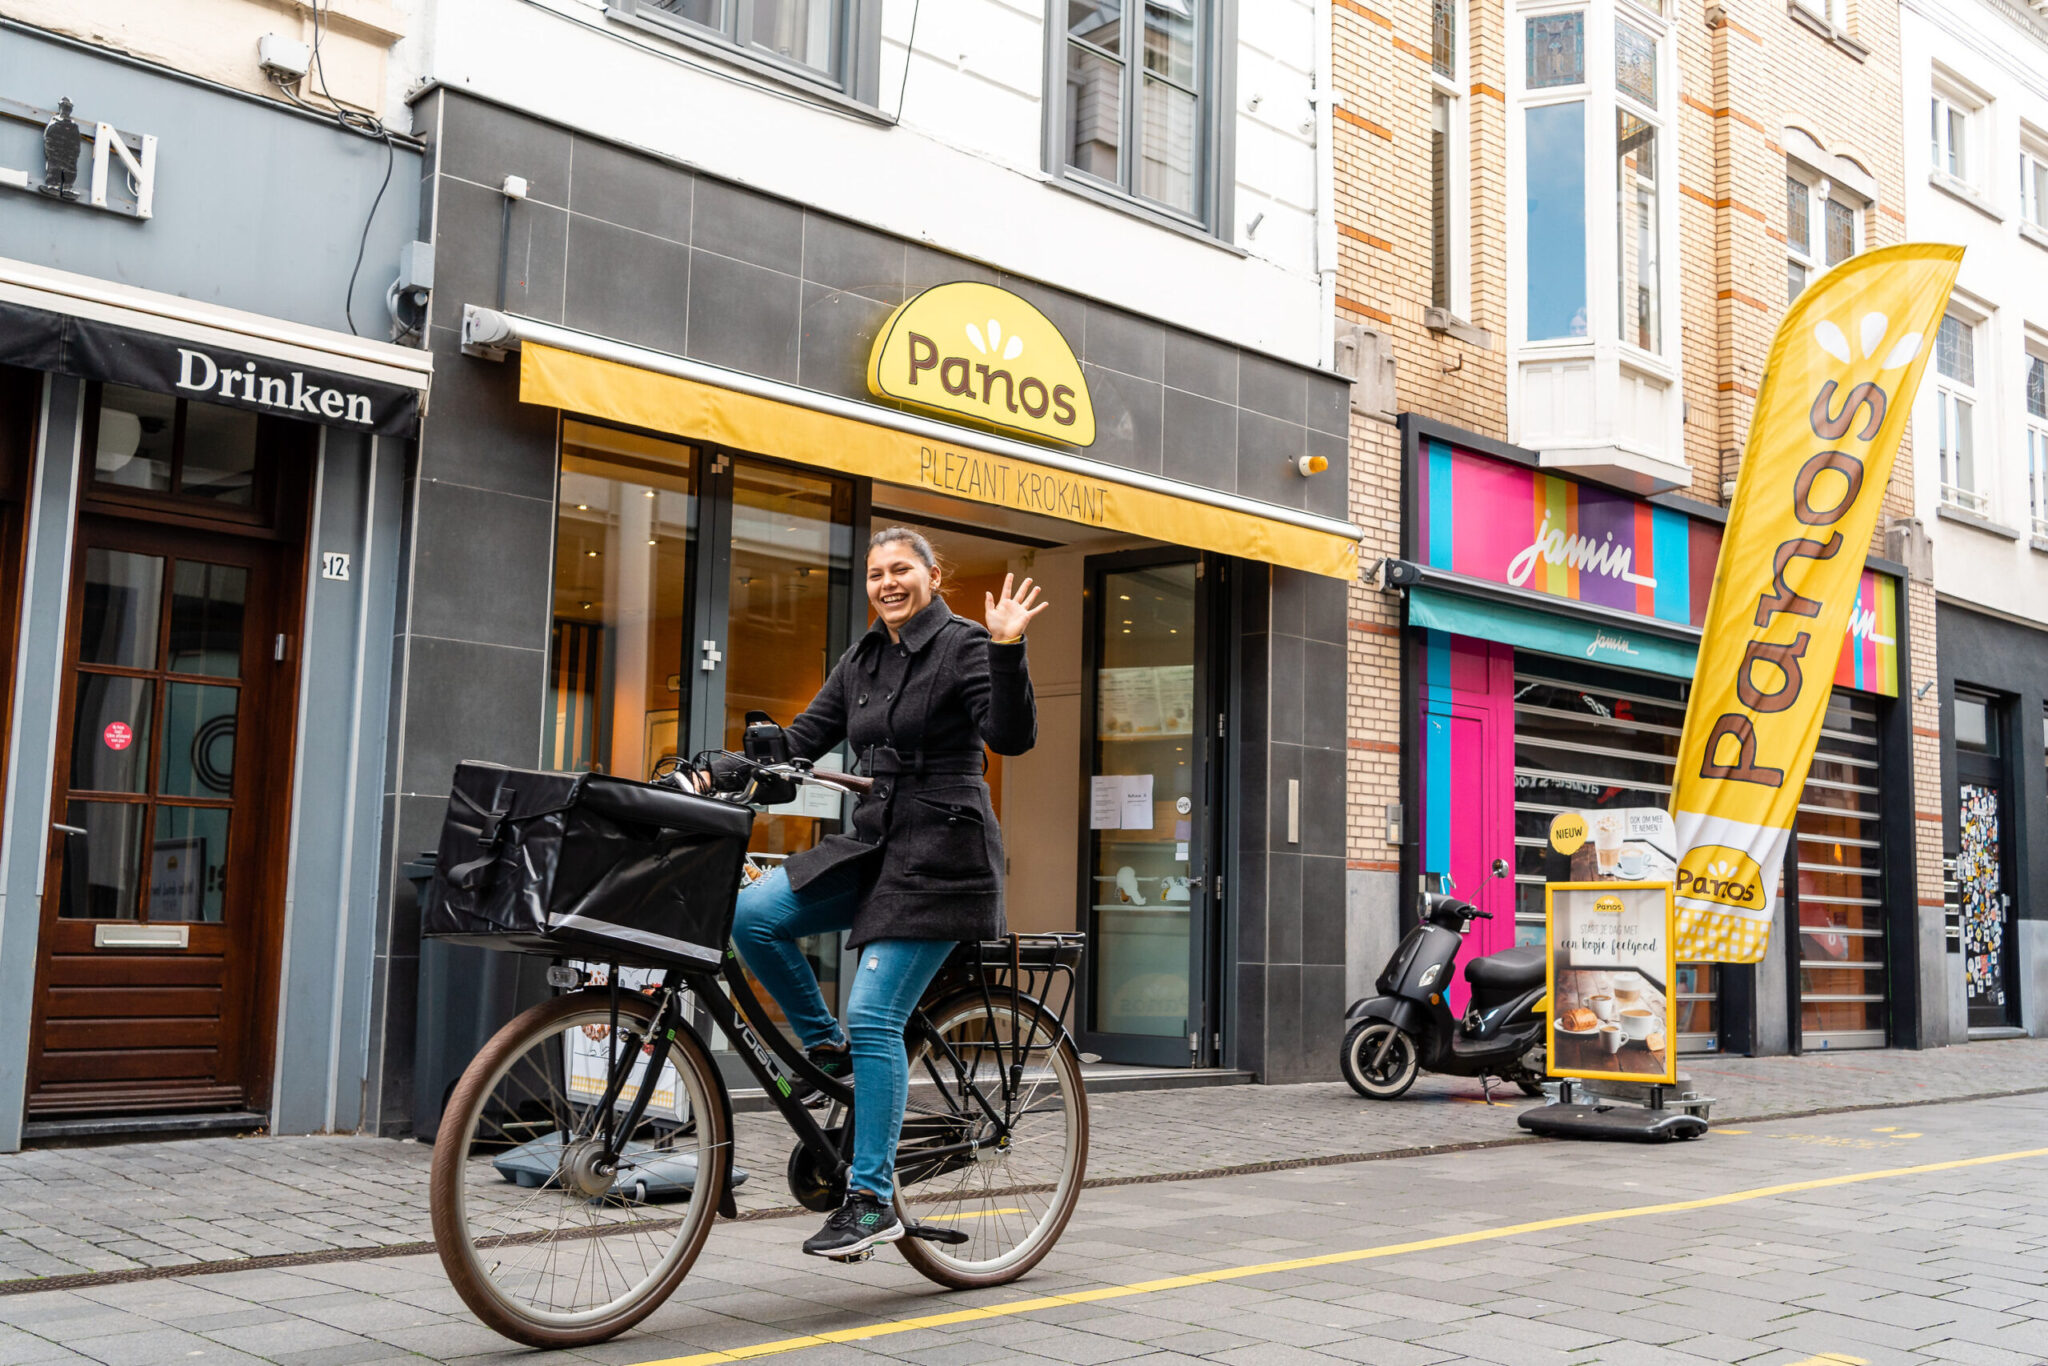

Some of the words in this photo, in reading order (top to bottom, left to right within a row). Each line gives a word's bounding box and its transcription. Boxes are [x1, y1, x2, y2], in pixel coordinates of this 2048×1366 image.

[176, 348, 374, 425] Drinken
[909, 331, 1076, 426] Panos
[920, 446, 1010, 501] PLEZANT
[1017, 469, 1108, 523] KROKANT
[329, 556, 344, 577] 12
[1507, 509, 1657, 588] jamin
[1700, 379, 1888, 789] Panos
[1586, 629, 1639, 657] jamin
[1556, 826, 1583, 840] NIEUW
[1596, 903, 1622, 911] Panos
[1676, 868, 1755, 902] Panos
[1623, 924, 1638, 935] MET
[733, 1010, 792, 1098] VOGUE
